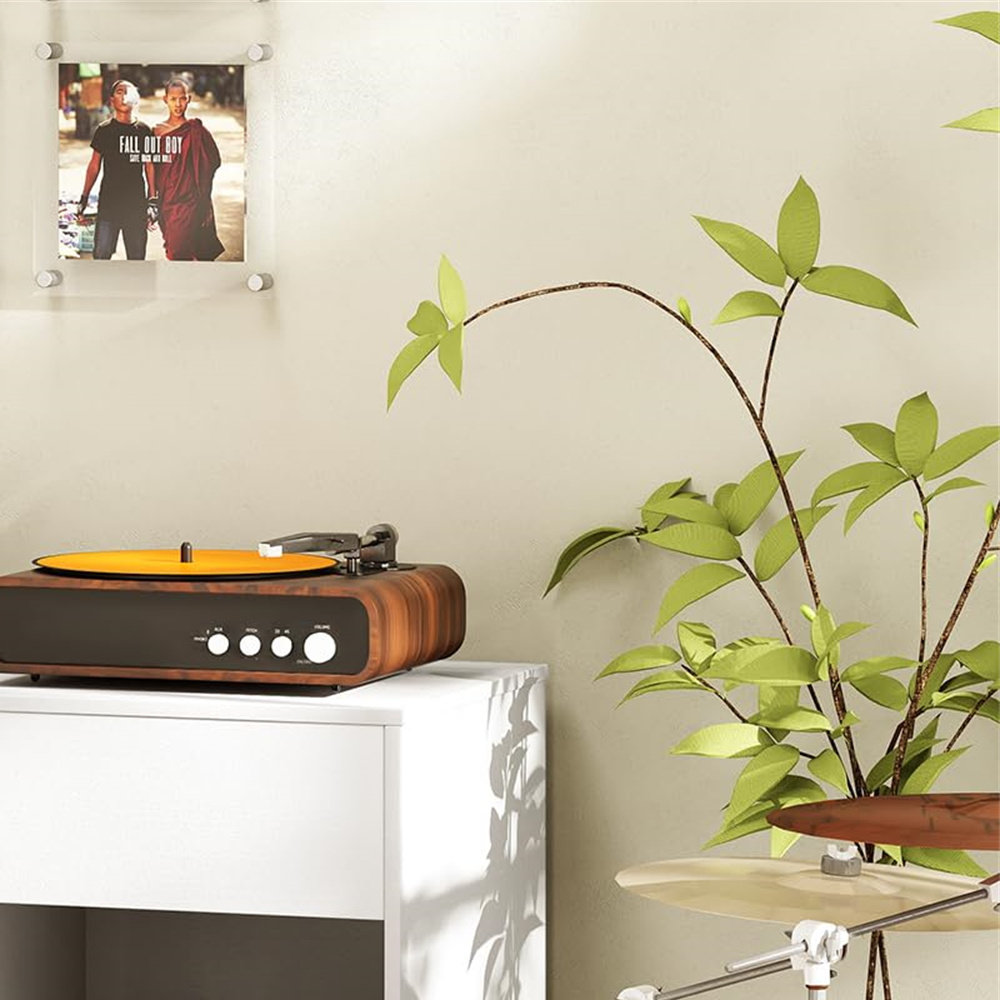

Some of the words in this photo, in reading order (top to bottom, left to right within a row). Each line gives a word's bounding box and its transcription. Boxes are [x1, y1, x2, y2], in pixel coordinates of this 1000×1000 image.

[119, 136, 140, 153] FALL
[144, 136, 161, 153] OUT
[165, 136, 183, 154] BOY
